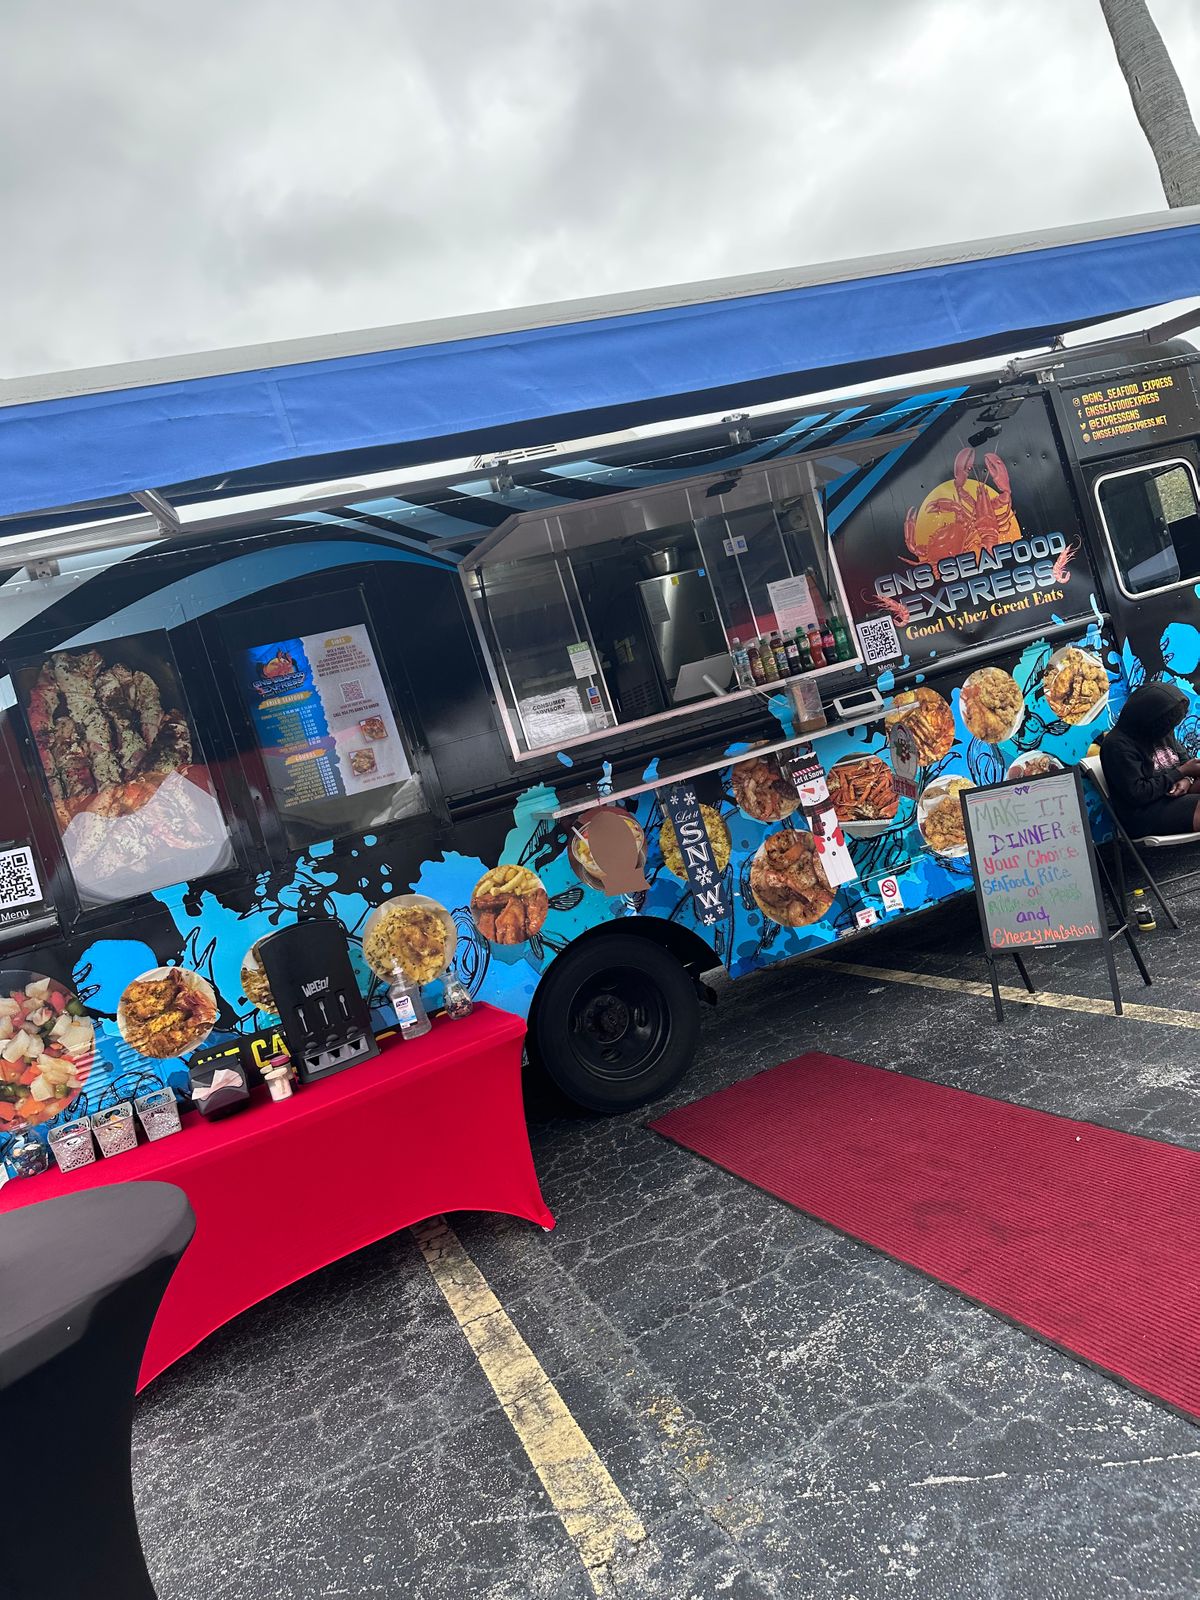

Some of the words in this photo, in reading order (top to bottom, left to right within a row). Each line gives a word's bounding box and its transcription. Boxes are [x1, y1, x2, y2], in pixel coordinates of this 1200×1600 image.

[1082, 376, 1173, 405] @GNS_SEAFOOD_EXPRESS
[1085, 392, 1160, 417] GNSSEAFOODEXPRESS
[1088, 409, 1140, 430] @EXPRESSGNS
[874, 562, 935, 597] GNS
[937, 532, 1066, 582] SEAFOOD
[900, 559, 1056, 622] EXPRESS
[905, 618, 945, 641] Good
[945, 610, 988, 631] Vybez
[990, 599, 1030, 617] Great
[1032, 588, 1064, 607] Eats
[533, 697, 566, 711] CONSUMER
[535, 703, 566, 715] ADVISORY
[793, 776, 804, 785] Let
[808, 769, 824, 779] Snow
[975, 798, 1028, 831] MAKE
[1035, 795, 1068, 818] IT
[988, 821, 1066, 856] DINNER
[0, 909, 30, 922] Menu
[991, 927, 1042, 948] Cheezy
